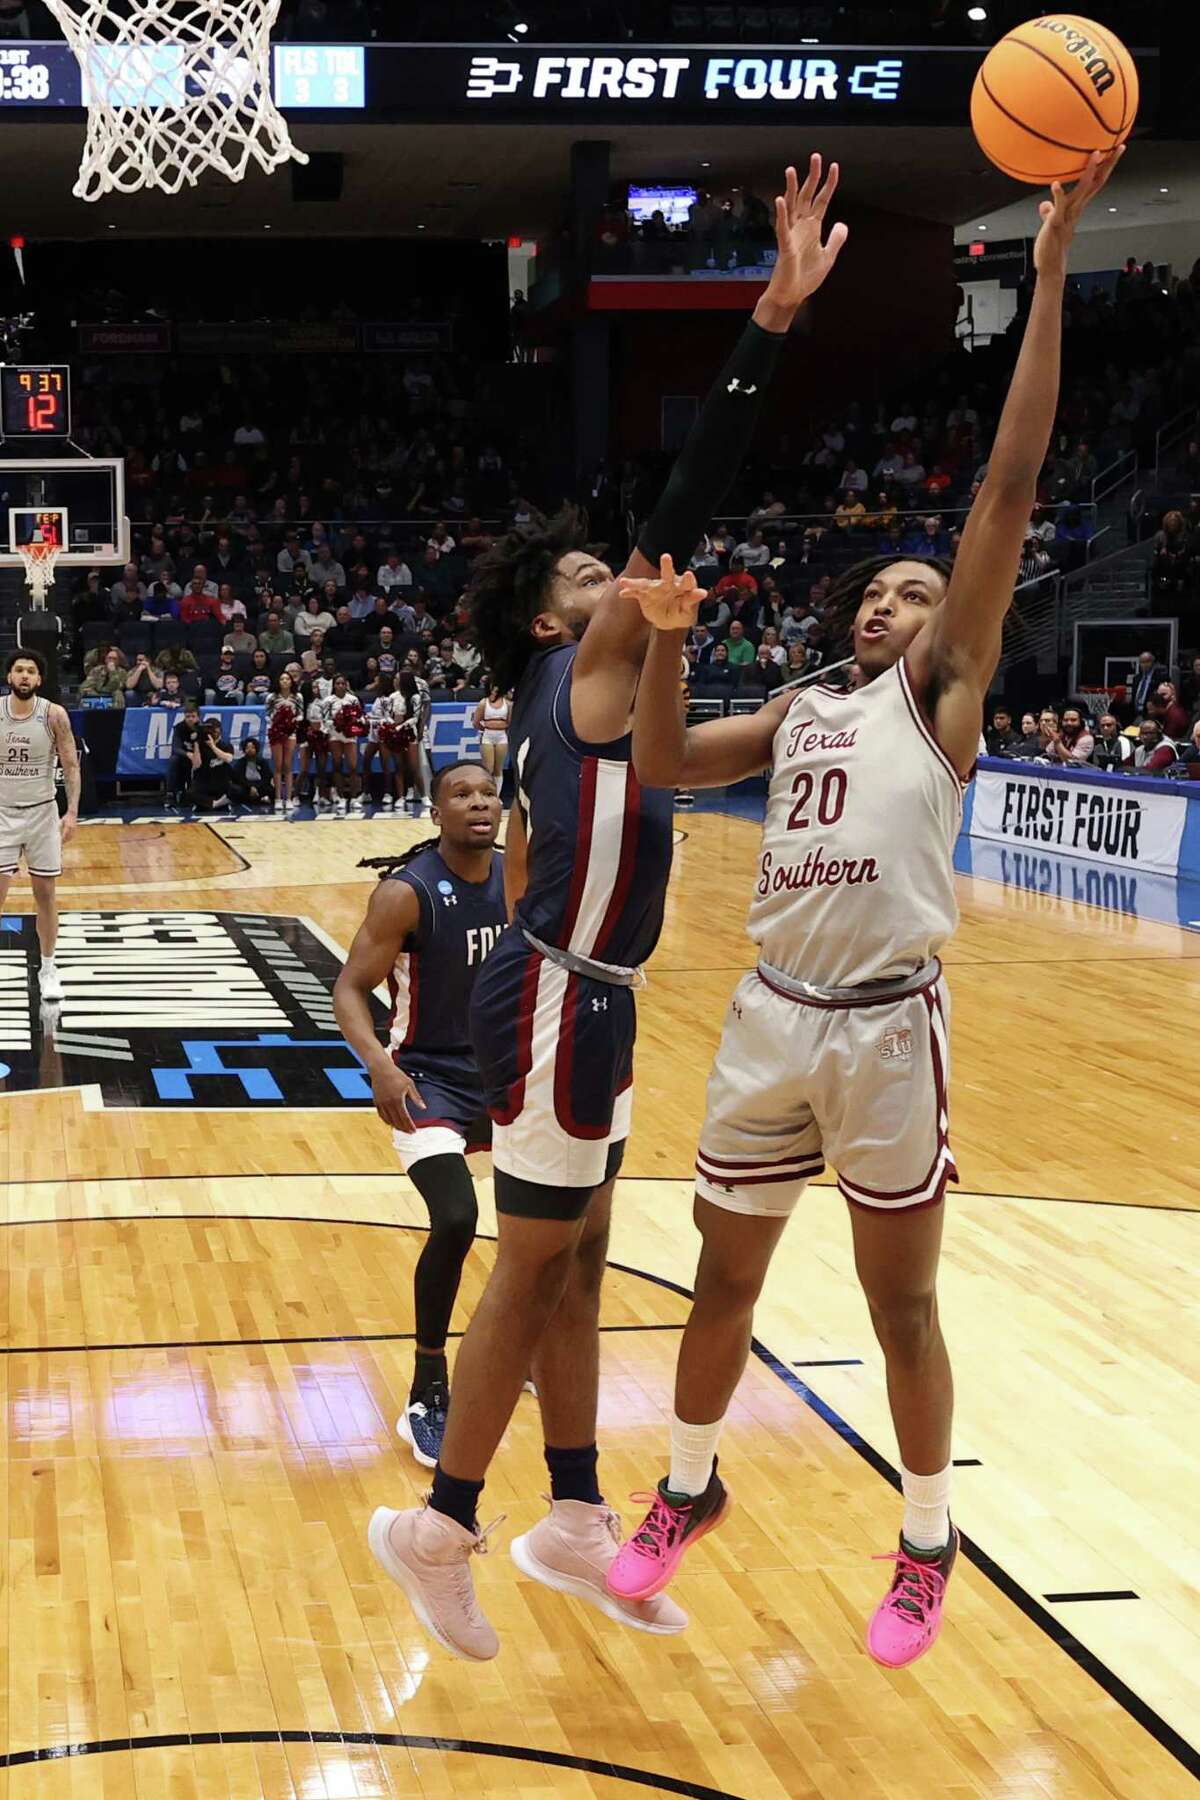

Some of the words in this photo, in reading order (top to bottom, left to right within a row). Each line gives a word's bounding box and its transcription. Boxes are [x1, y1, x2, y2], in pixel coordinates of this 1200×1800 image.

[533, 57, 690, 98] FIRST
[705, 59, 838, 99] FOUR
[1033, 20, 1115, 97] Wilson
[0, 64, 49, 99] :38
[29, 394, 55, 429] 12
[8, 748, 29, 762] 25
[787, 719, 858, 758] Texas
[787, 768, 847, 831] 20
[1002, 782, 1069, 844] FIRST
[1072, 793, 1141, 859] FOUR
[758, 846, 878, 895] Southern
[466, 923, 510, 966] FD
